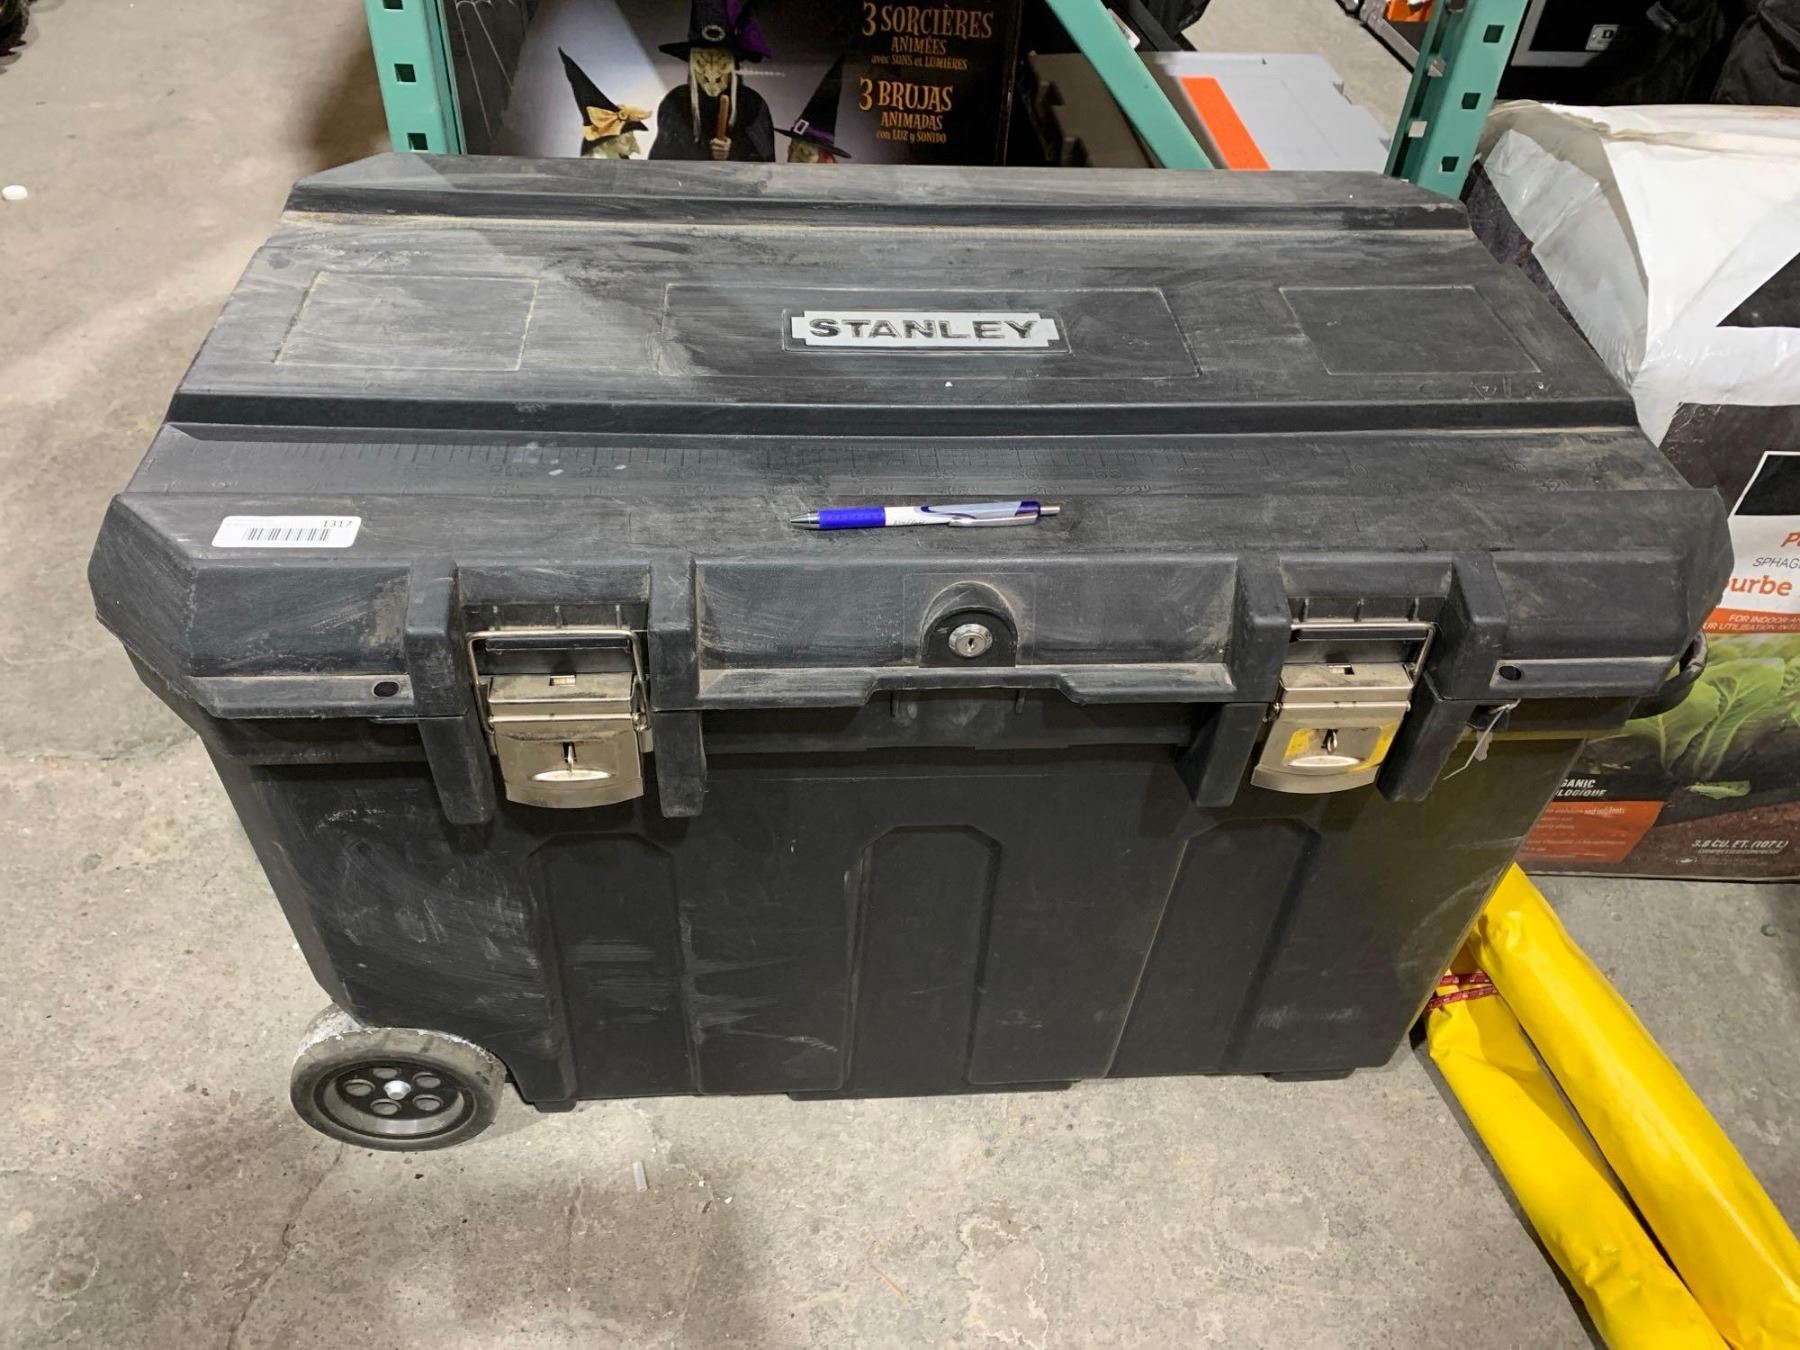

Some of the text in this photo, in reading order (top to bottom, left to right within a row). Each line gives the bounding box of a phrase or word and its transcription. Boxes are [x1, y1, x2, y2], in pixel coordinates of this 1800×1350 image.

[862, 2, 993, 39] 3 SORCIÈRES
[891, 35, 947, 55] ANIMÉES
[871, 56, 889, 65] avec
[891, 55, 913, 67] SONS
[914, 57, 923, 66] et
[858, 77, 953, 113] 3 BRUJAS
[881, 111, 943, 130] ANIMADAS
[876, 130, 891, 140] con
[892, 130, 909, 140] LUZ
[916, 130, 946, 143] SONIDO
[809, 317, 1038, 340] STANLEY
[323, 519, 352, 527] 1317
[1752, 557, 1800, 569] SPHAG
[1727, 575, 1793, 596] urbe
[1729, 614, 1749, 622] FOR
[1557, 789, 1608, 797] LOGIQUE
